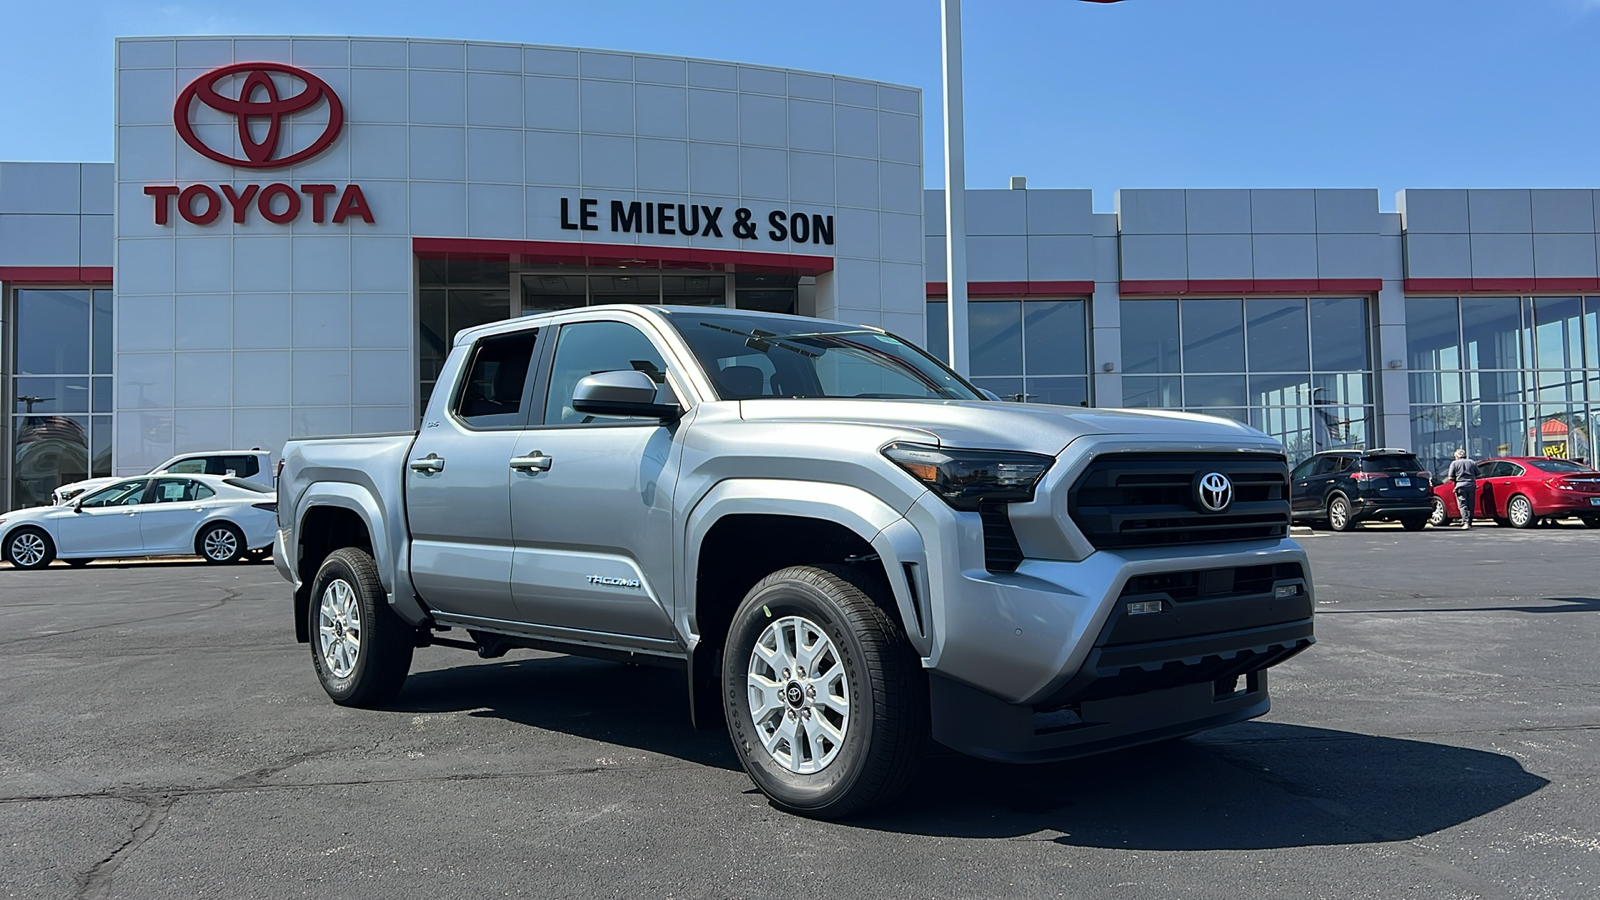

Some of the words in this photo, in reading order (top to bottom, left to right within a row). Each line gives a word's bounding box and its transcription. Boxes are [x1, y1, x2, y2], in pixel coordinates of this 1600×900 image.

[143, 183, 376, 226] TOYOTA
[560, 197, 599, 231] LE
[610, 200, 724, 238] MIEUX
[732, 207, 758, 240] &
[768, 210, 835, 245] SON
[586, 574, 642, 589] TACOMA
